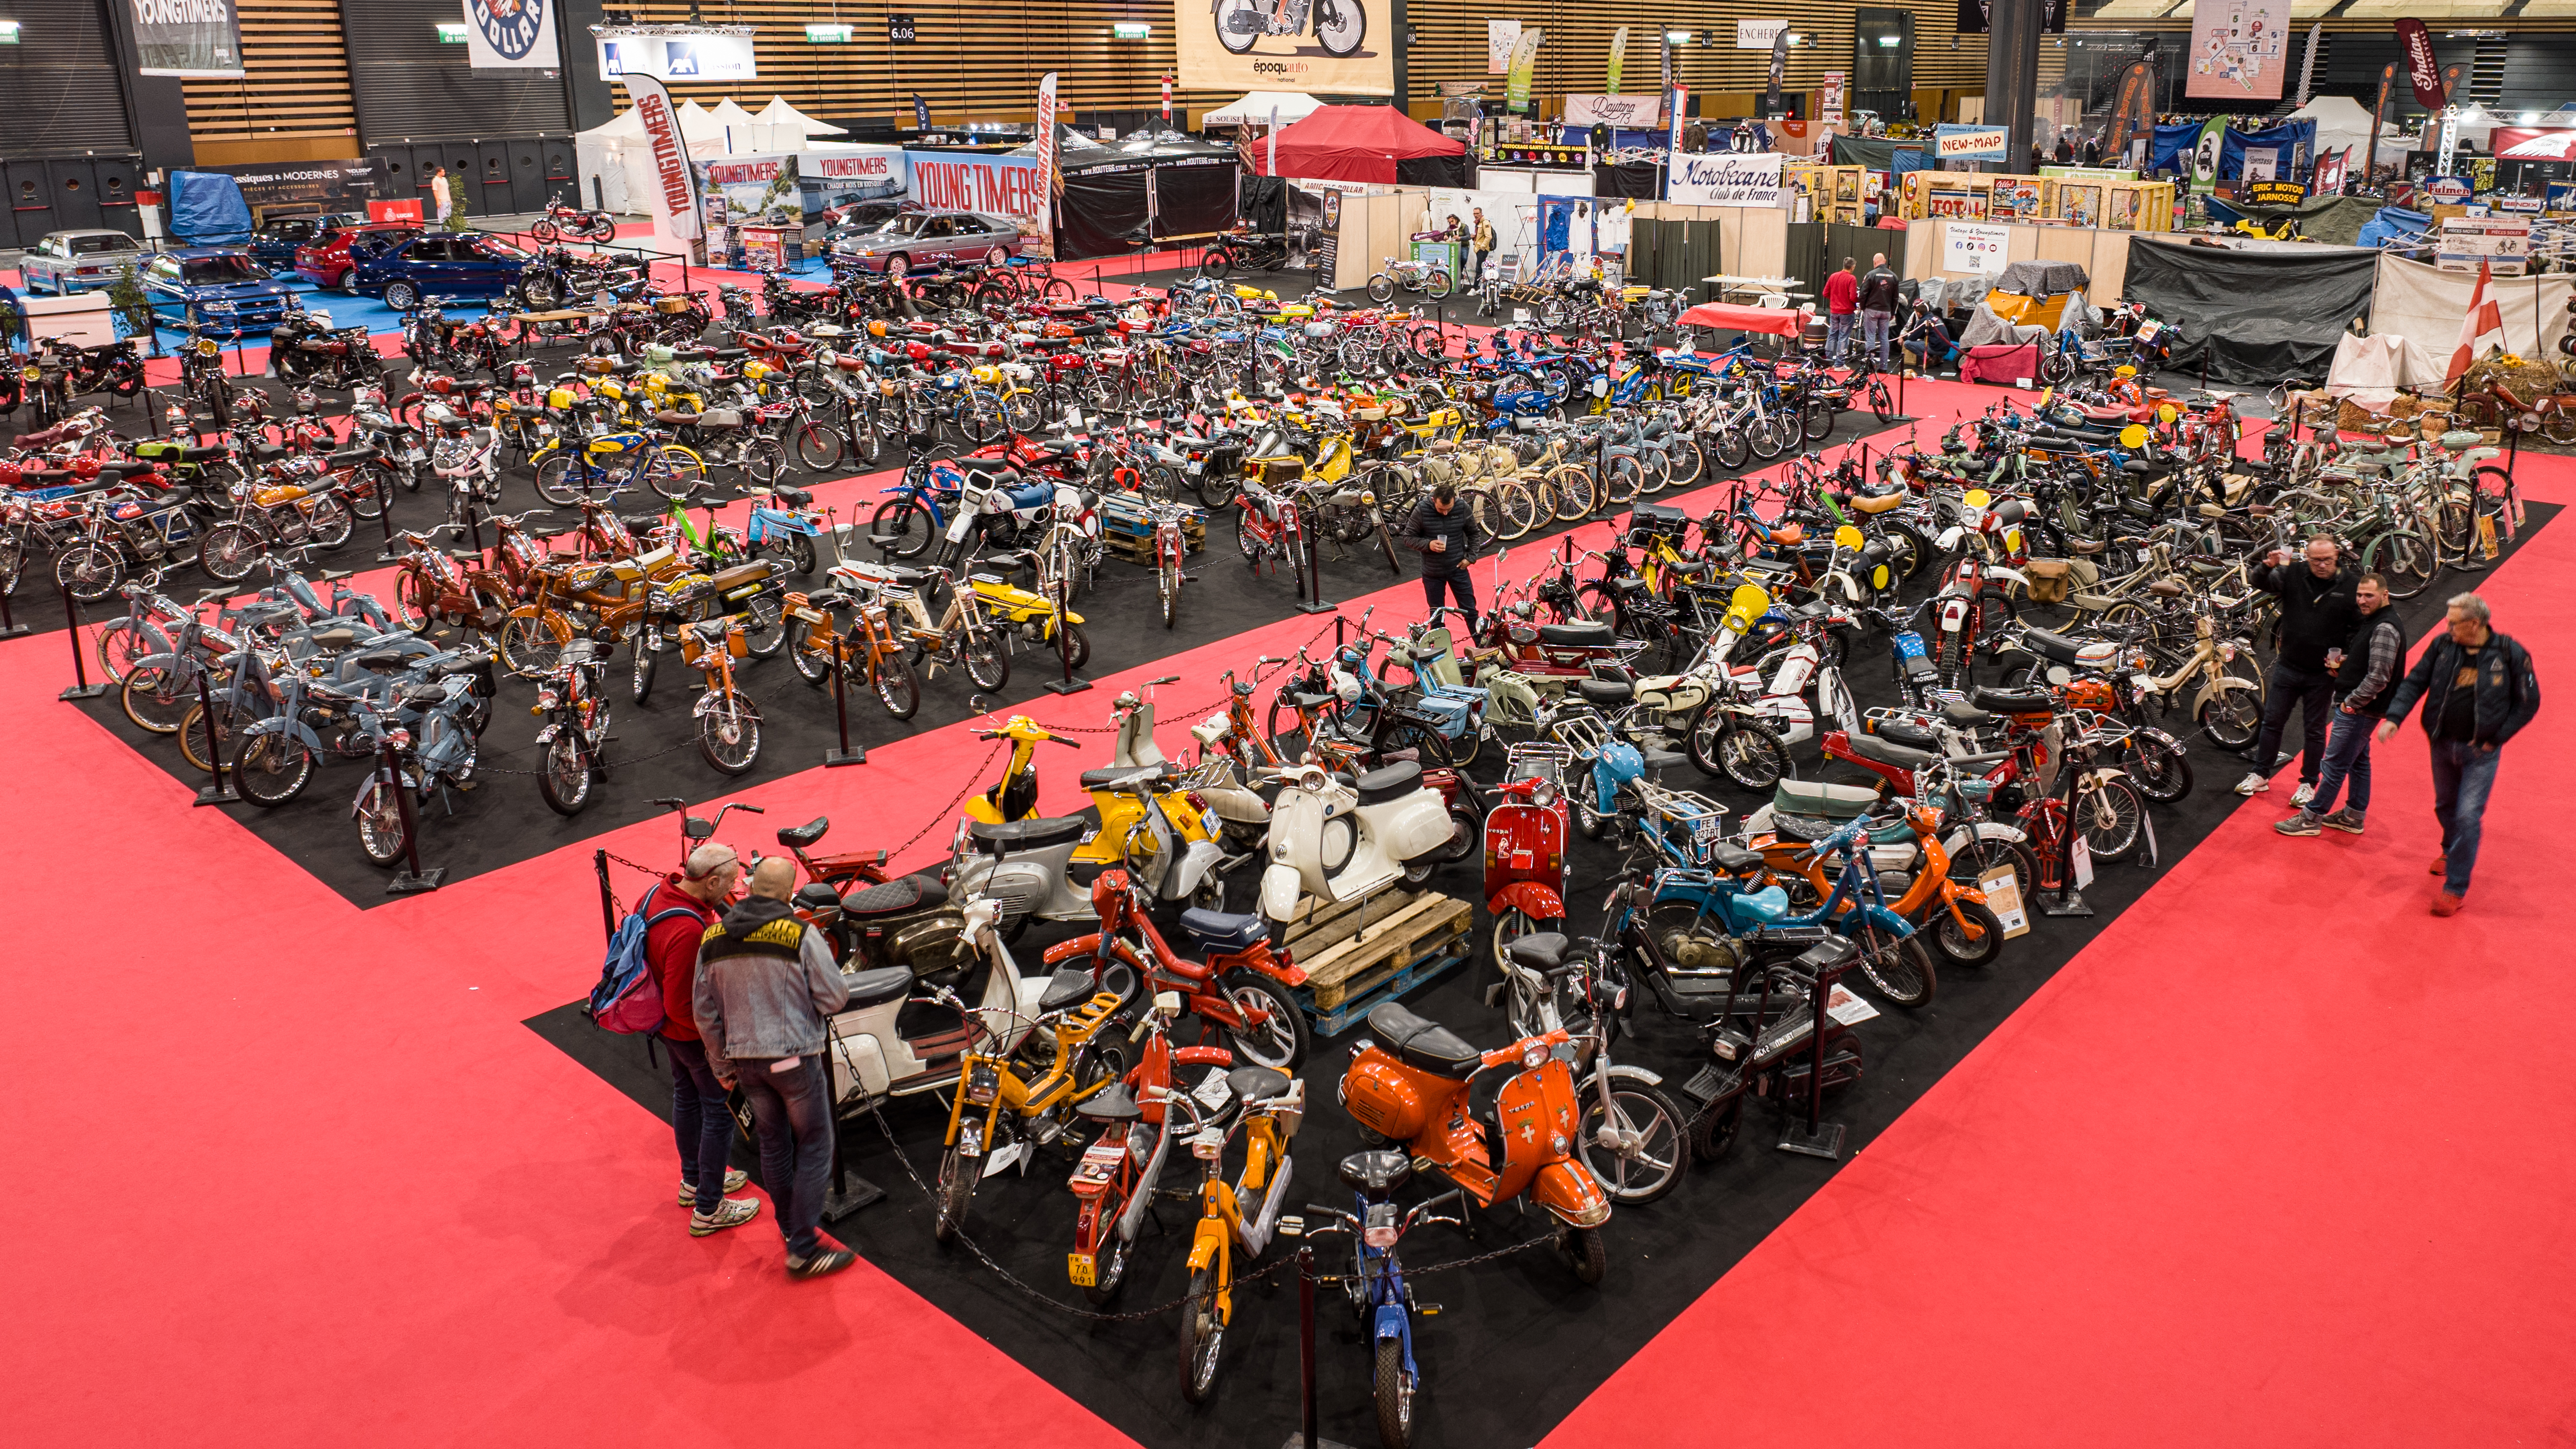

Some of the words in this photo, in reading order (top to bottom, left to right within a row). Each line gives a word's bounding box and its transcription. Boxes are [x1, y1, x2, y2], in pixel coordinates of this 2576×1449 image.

[133, 0, 227, 24] YOUNGTIMERS
[476, 0, 540, 53] DOLLAR
[891, 28, 914, 39] 6.06
[2410, 32, 2433, 91] Indian
[2420, 30, 2438, 86] MOTORCYCLE
[704, 62, 741, 70] Passion
[1254, 58, 1308, 75] époquauto
[2118, 77, 2138, 119] ENFIELD
[1591, 96, 1636, 120] Daytona
[1620, 112, 1631, 125] 73
[1942, 135, 2001, 151] NEW-MAP
[2109, 120, 2124, 153] ROYAL
[637, 93, 691, 217] YOUNGTIMERS
[1176, 157, 1220, 167] www.ROUTE66.STORE
[708, 162, 779, 184] YOUNGTIMERS
[820, 157, 887, 176] YOUNGTIMERS
[1081, 164, 1128, 175] www.ROUTE66.STORE
[1672, 159, 1779, 187] Motobécane
[283, 170, 339, 181] MODERNES
[827, 181, 844, 190] CHAQUE
[914, 161, 972, 211] YOUNG
[2253, 183, 2272, 192] ERIC
[2275, 183, 2304, 194] MOTOS
[2427, 183, 2470, 196] Fulmen
[1710, 188, 1730, 200] Club
[1734, 188, 1745, 199] de
[1747, 188, 1777, 201] France
[2256, 193, 2299, 203] JARNOSSE
[1932, 199, 1979, 216] TOTAL
[1796, 668, 1806, 683] XG1
[1912, 673, 1938, 683] MORINI
[1696, 828, 1718, 839] 327-RT
[1775, 1032, 1794, 1047] ITALJET
[1508, 1100, 1535, 1114] vespa
[1075, 1265, 1088, 1275] 70
[1073, 1276, 1092, 1285] 991
